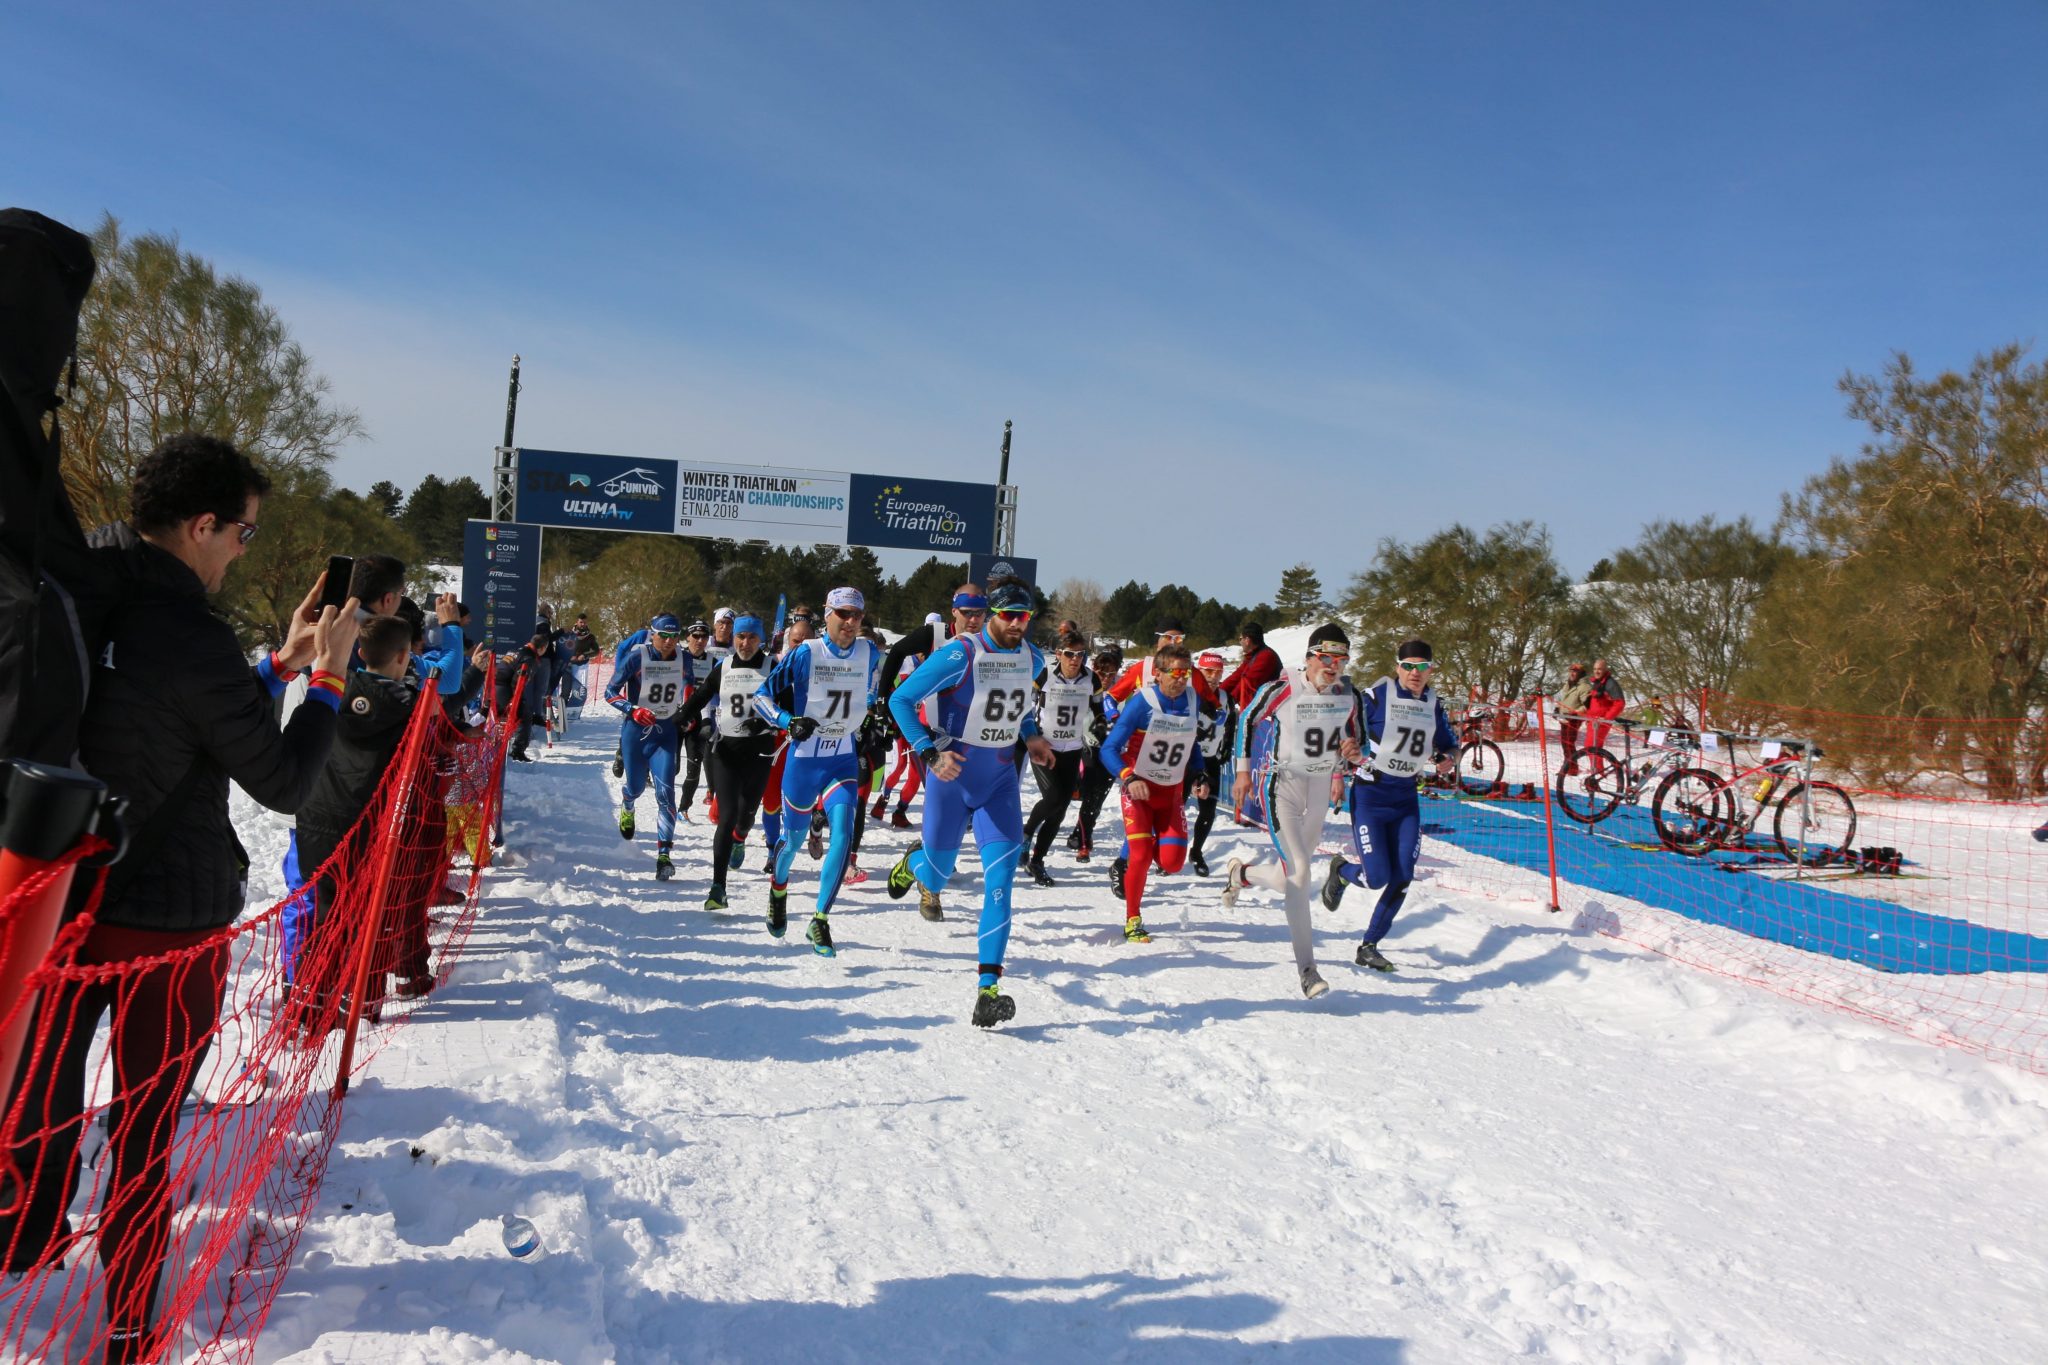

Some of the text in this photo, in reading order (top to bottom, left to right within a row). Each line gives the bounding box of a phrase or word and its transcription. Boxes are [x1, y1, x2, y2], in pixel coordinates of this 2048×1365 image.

[620, 480, 659, 496] FUNIVIA
[683, 471, 797, 493] WINTER TRIATHLON
[682, 486, 845, 511] EUROPEAN CHAMPIONSHIPS
[886, 498, 946, 513] European
[682, 501, 739, 519] ETNA 2018
[680, 518, 692, 526] ETU
[886, 511, 967, 534] Triathlon
[929, 533, 963, 546] Union
[648, 683, 678, 704] 86
[823, 689, 853, 720] 71
[983, 688, 1026, 722] 63
[1057, 705, 1079, 727] 51
[820, 740, 838, 751] ITA
[1149, 739, 1185, 767] 36
[1304, 727, 1342, 758] 94
[1393, 726, 1427, 758] 78
[1359, 824, 1373, 855] GBR
